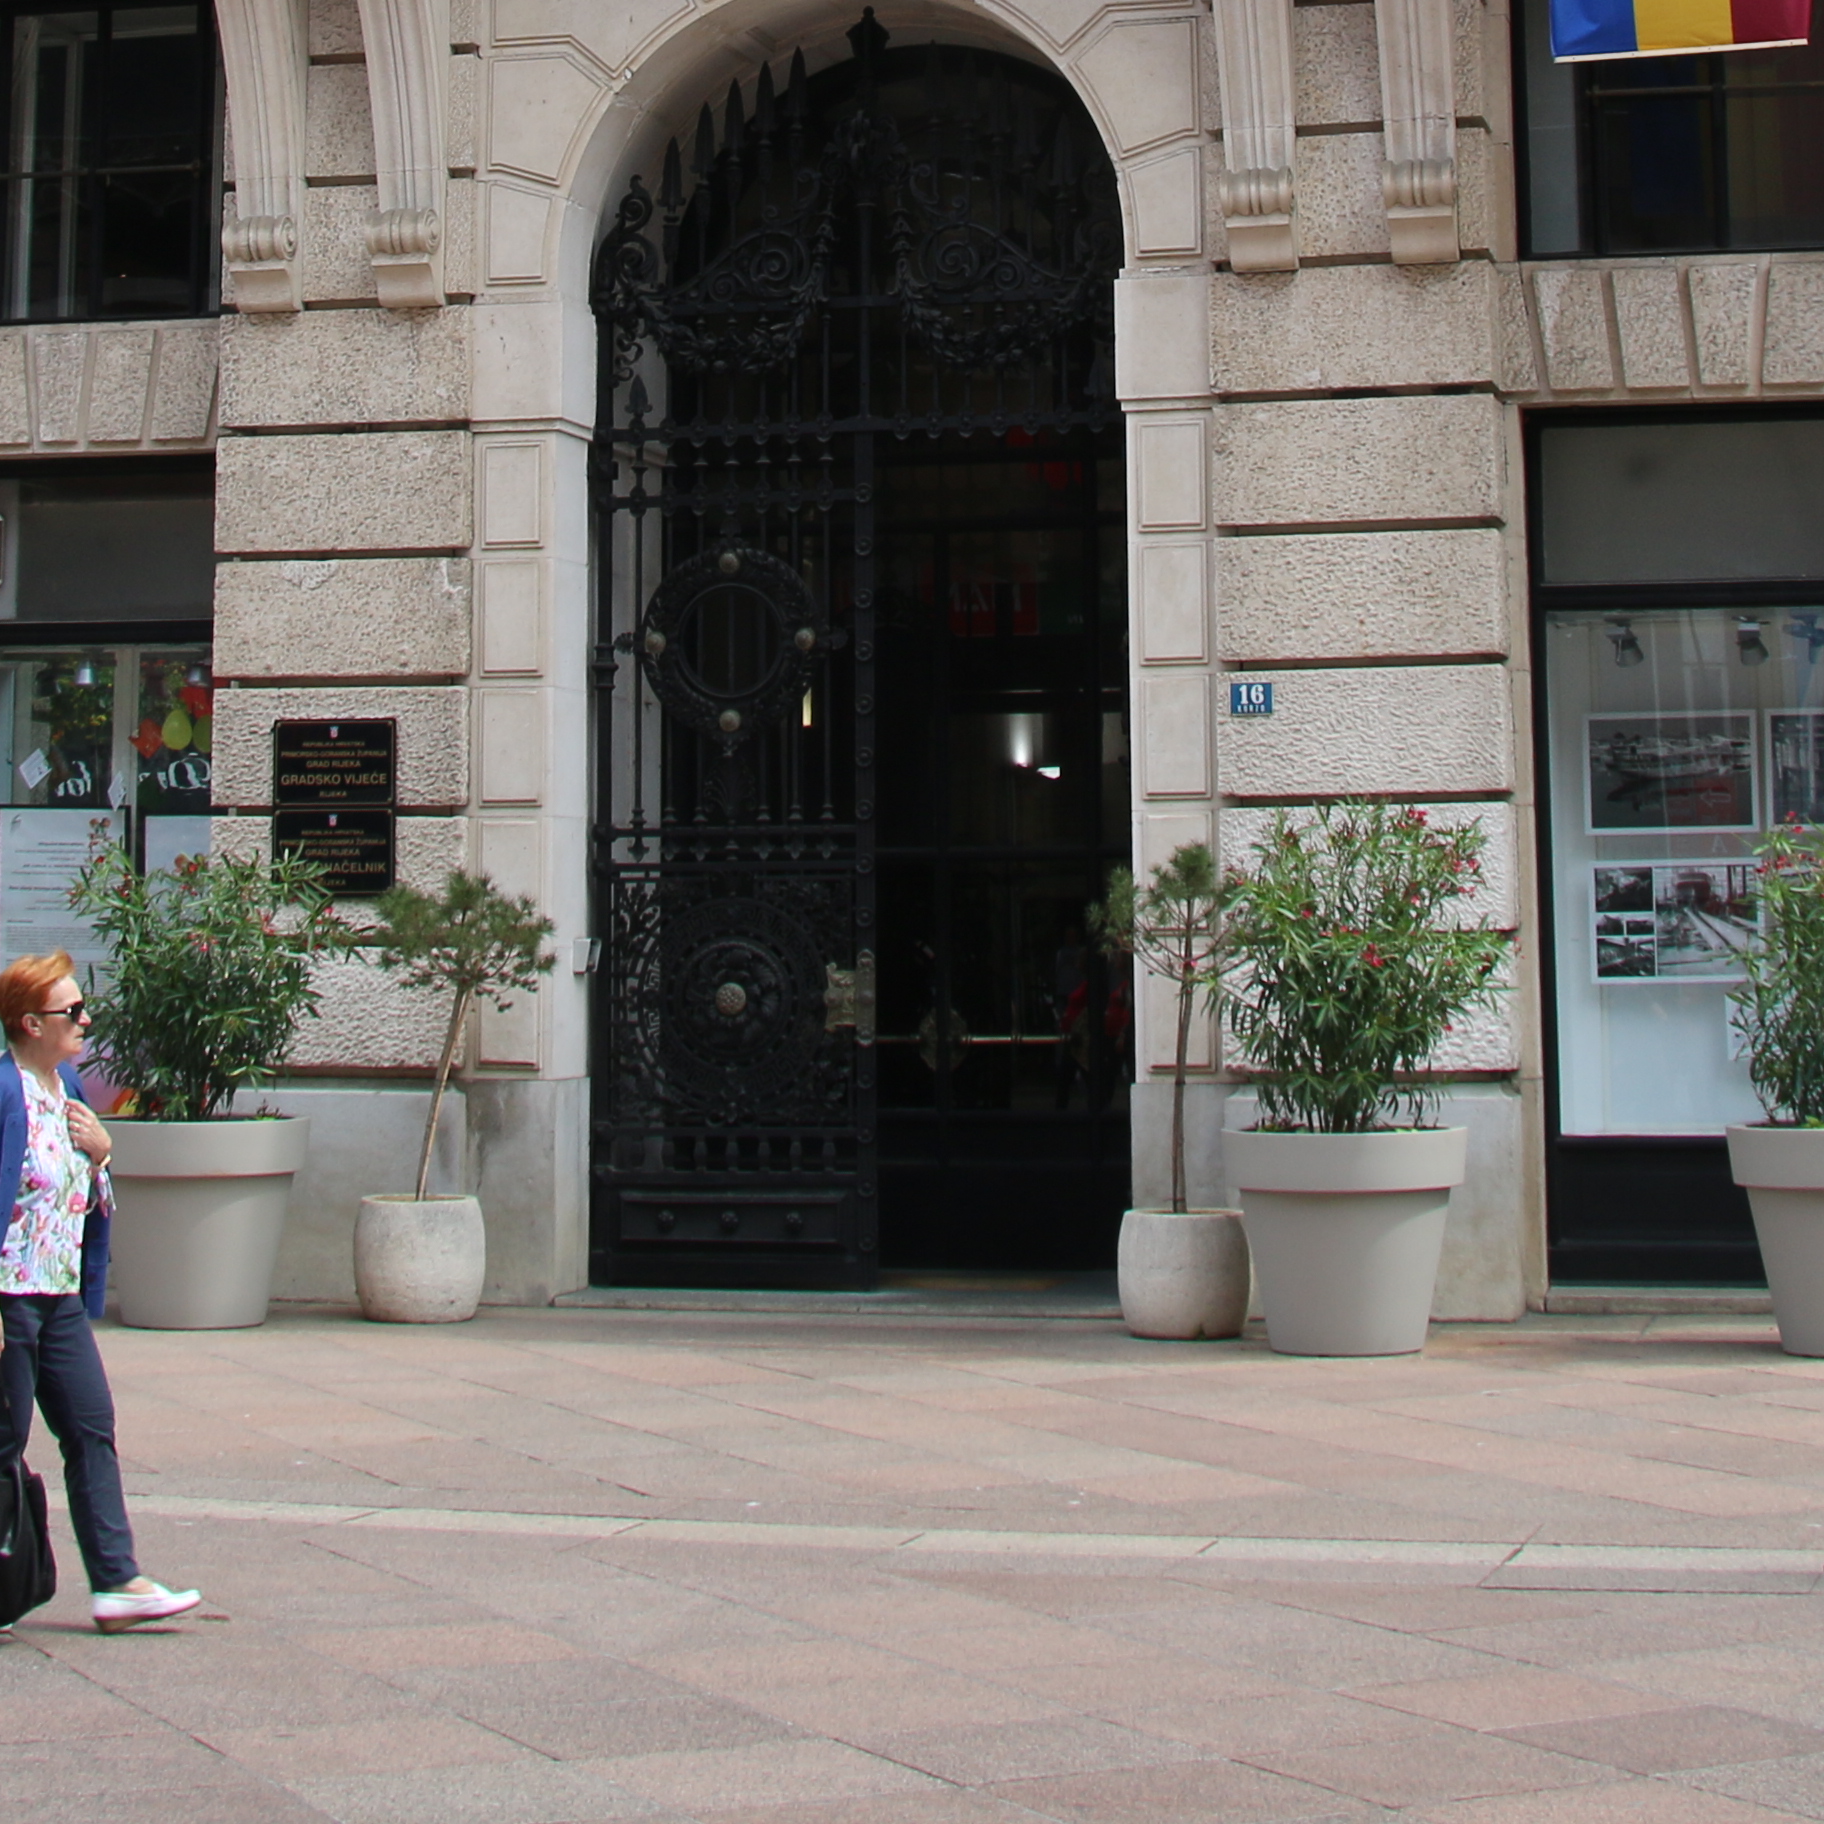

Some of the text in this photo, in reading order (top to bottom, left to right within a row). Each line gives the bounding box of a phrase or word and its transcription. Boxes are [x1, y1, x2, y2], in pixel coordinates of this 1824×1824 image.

[1239, 684, 1264, 704] 16
[306, 760, 361, 768] GRAD RIJEKA
[280, 771, 387, 785] GRADSKO VIJEĆE
[305, 848, 360, 856] GRAD RIJEKA
